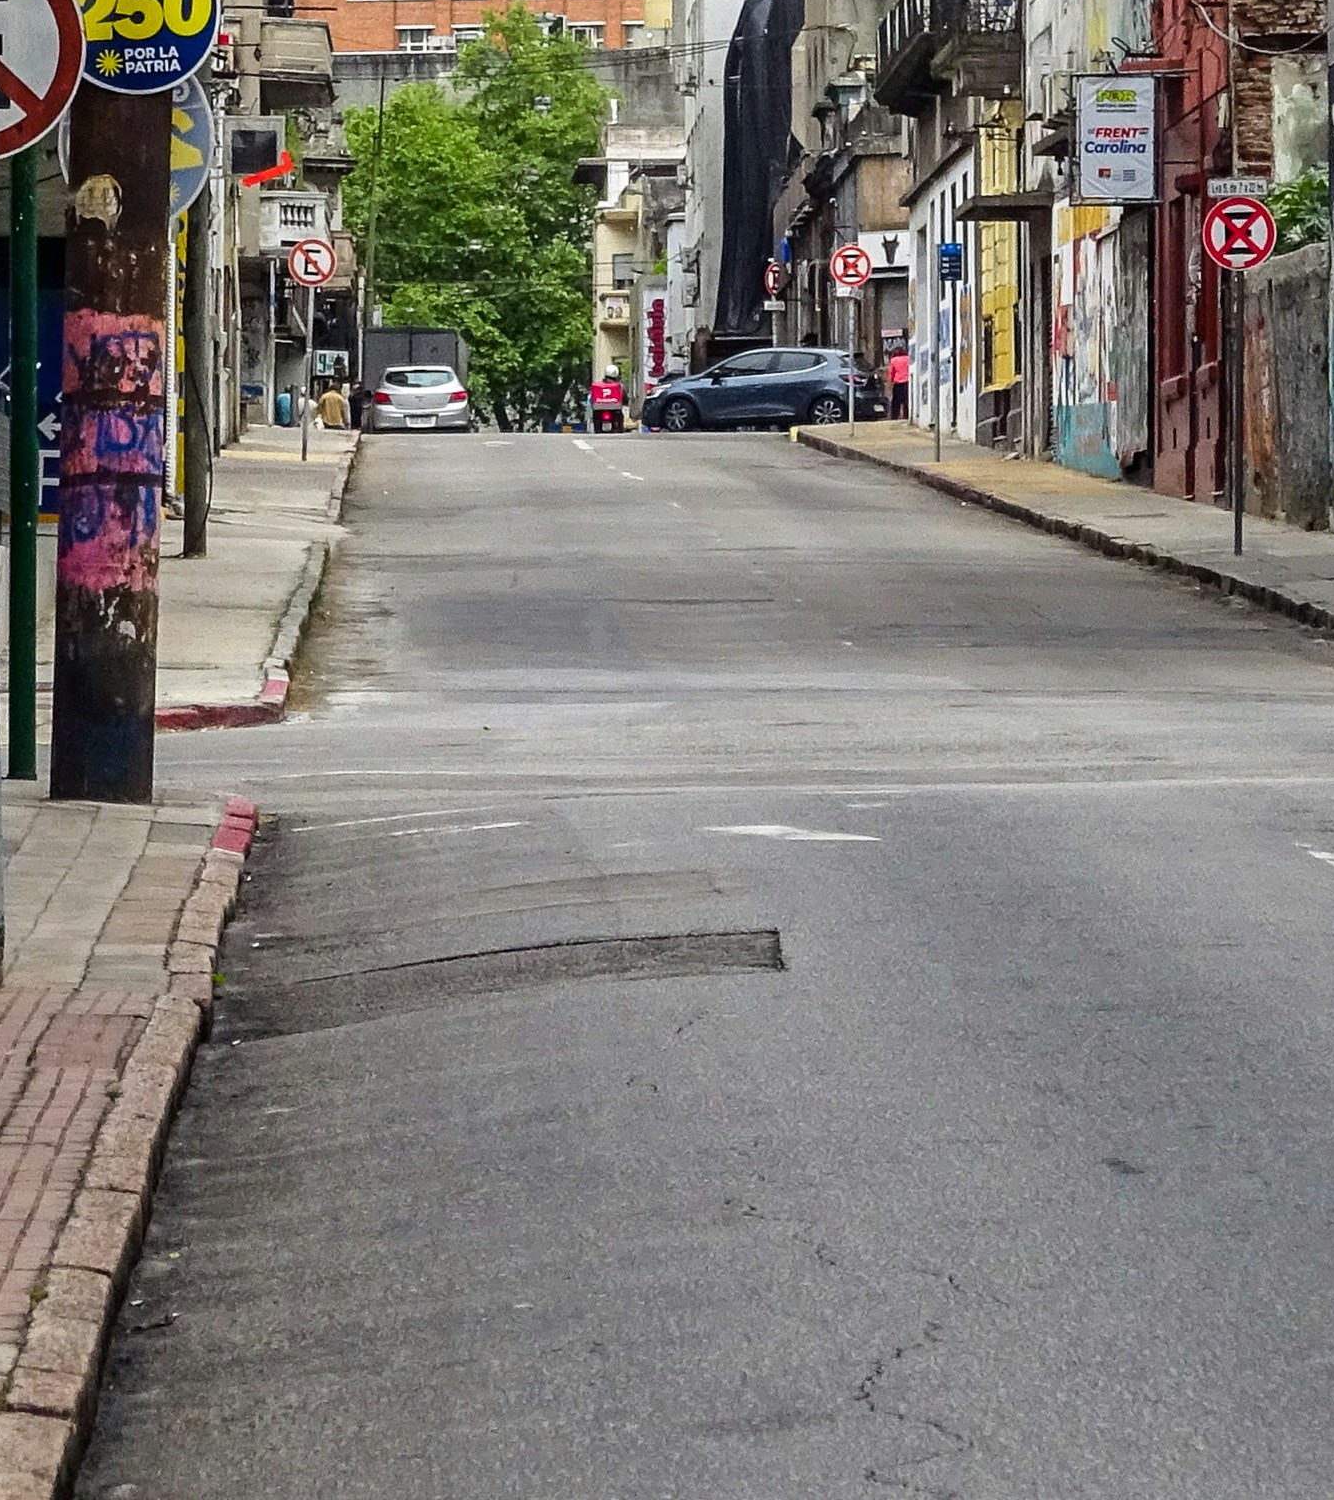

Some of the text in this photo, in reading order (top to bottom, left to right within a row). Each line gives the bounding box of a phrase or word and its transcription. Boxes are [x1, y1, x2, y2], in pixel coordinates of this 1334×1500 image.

[124, 46, 179, 61] POR LA
[124, 59, 182, 74] PATRIA
[1084, 139, 1147, 154] Carolina
